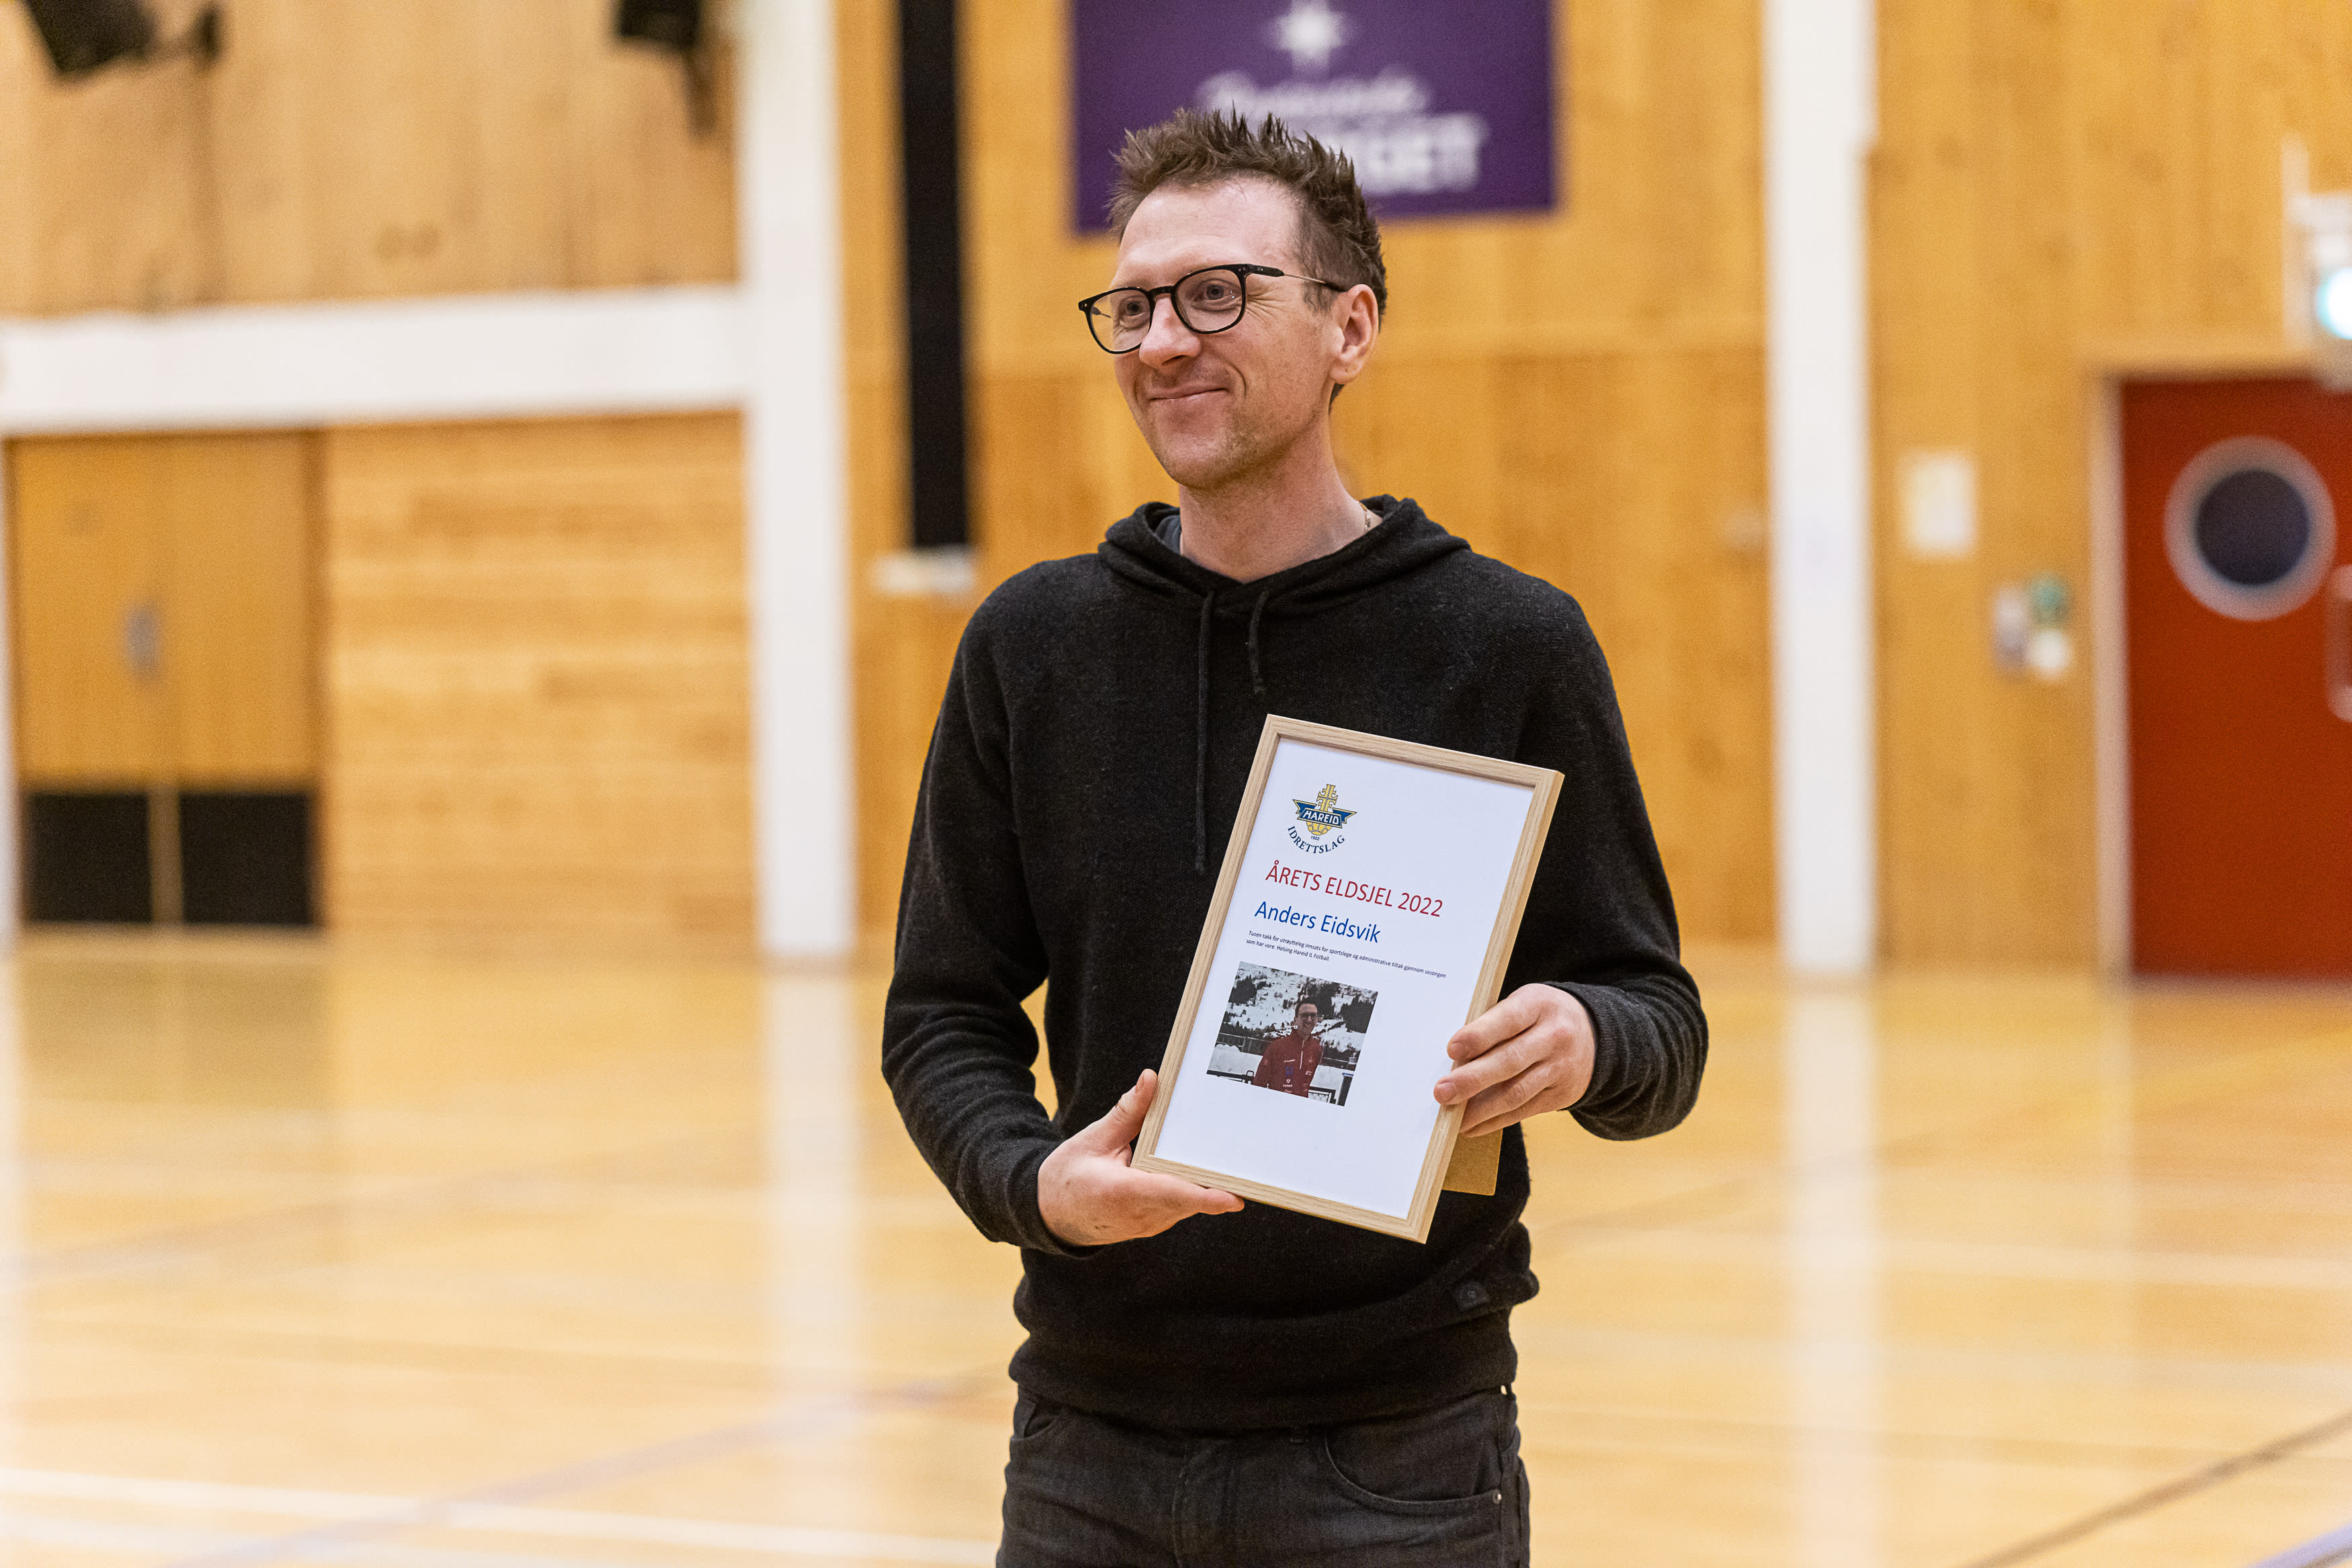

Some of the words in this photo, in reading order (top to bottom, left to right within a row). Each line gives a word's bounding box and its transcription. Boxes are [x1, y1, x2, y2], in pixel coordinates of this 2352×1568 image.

[1302, 810, 1339, 825] HAREID
[1288, 826, 1345, 854] IDRETTSLAG
[1265, 859, 1322, 891] ÅRETS
[1325, 877, 1392, 907] ELDSJEL
[1398, 892, 1443, 917] 2022
[1255, 901, 1316, 929] Anders
[1321, 914, 1381, 943] Eidsvik
[1277, 946, 1292, 954] Helsing
[1280, 939, 1304, 948] utrøytteleg
[1329, 949, 1351, 958] sportslege
[1359, 955, 1390, 966] administrative
[1404, 965, 1424, 973] gjennom
[1425, 969, 1446, 978] sesongen
